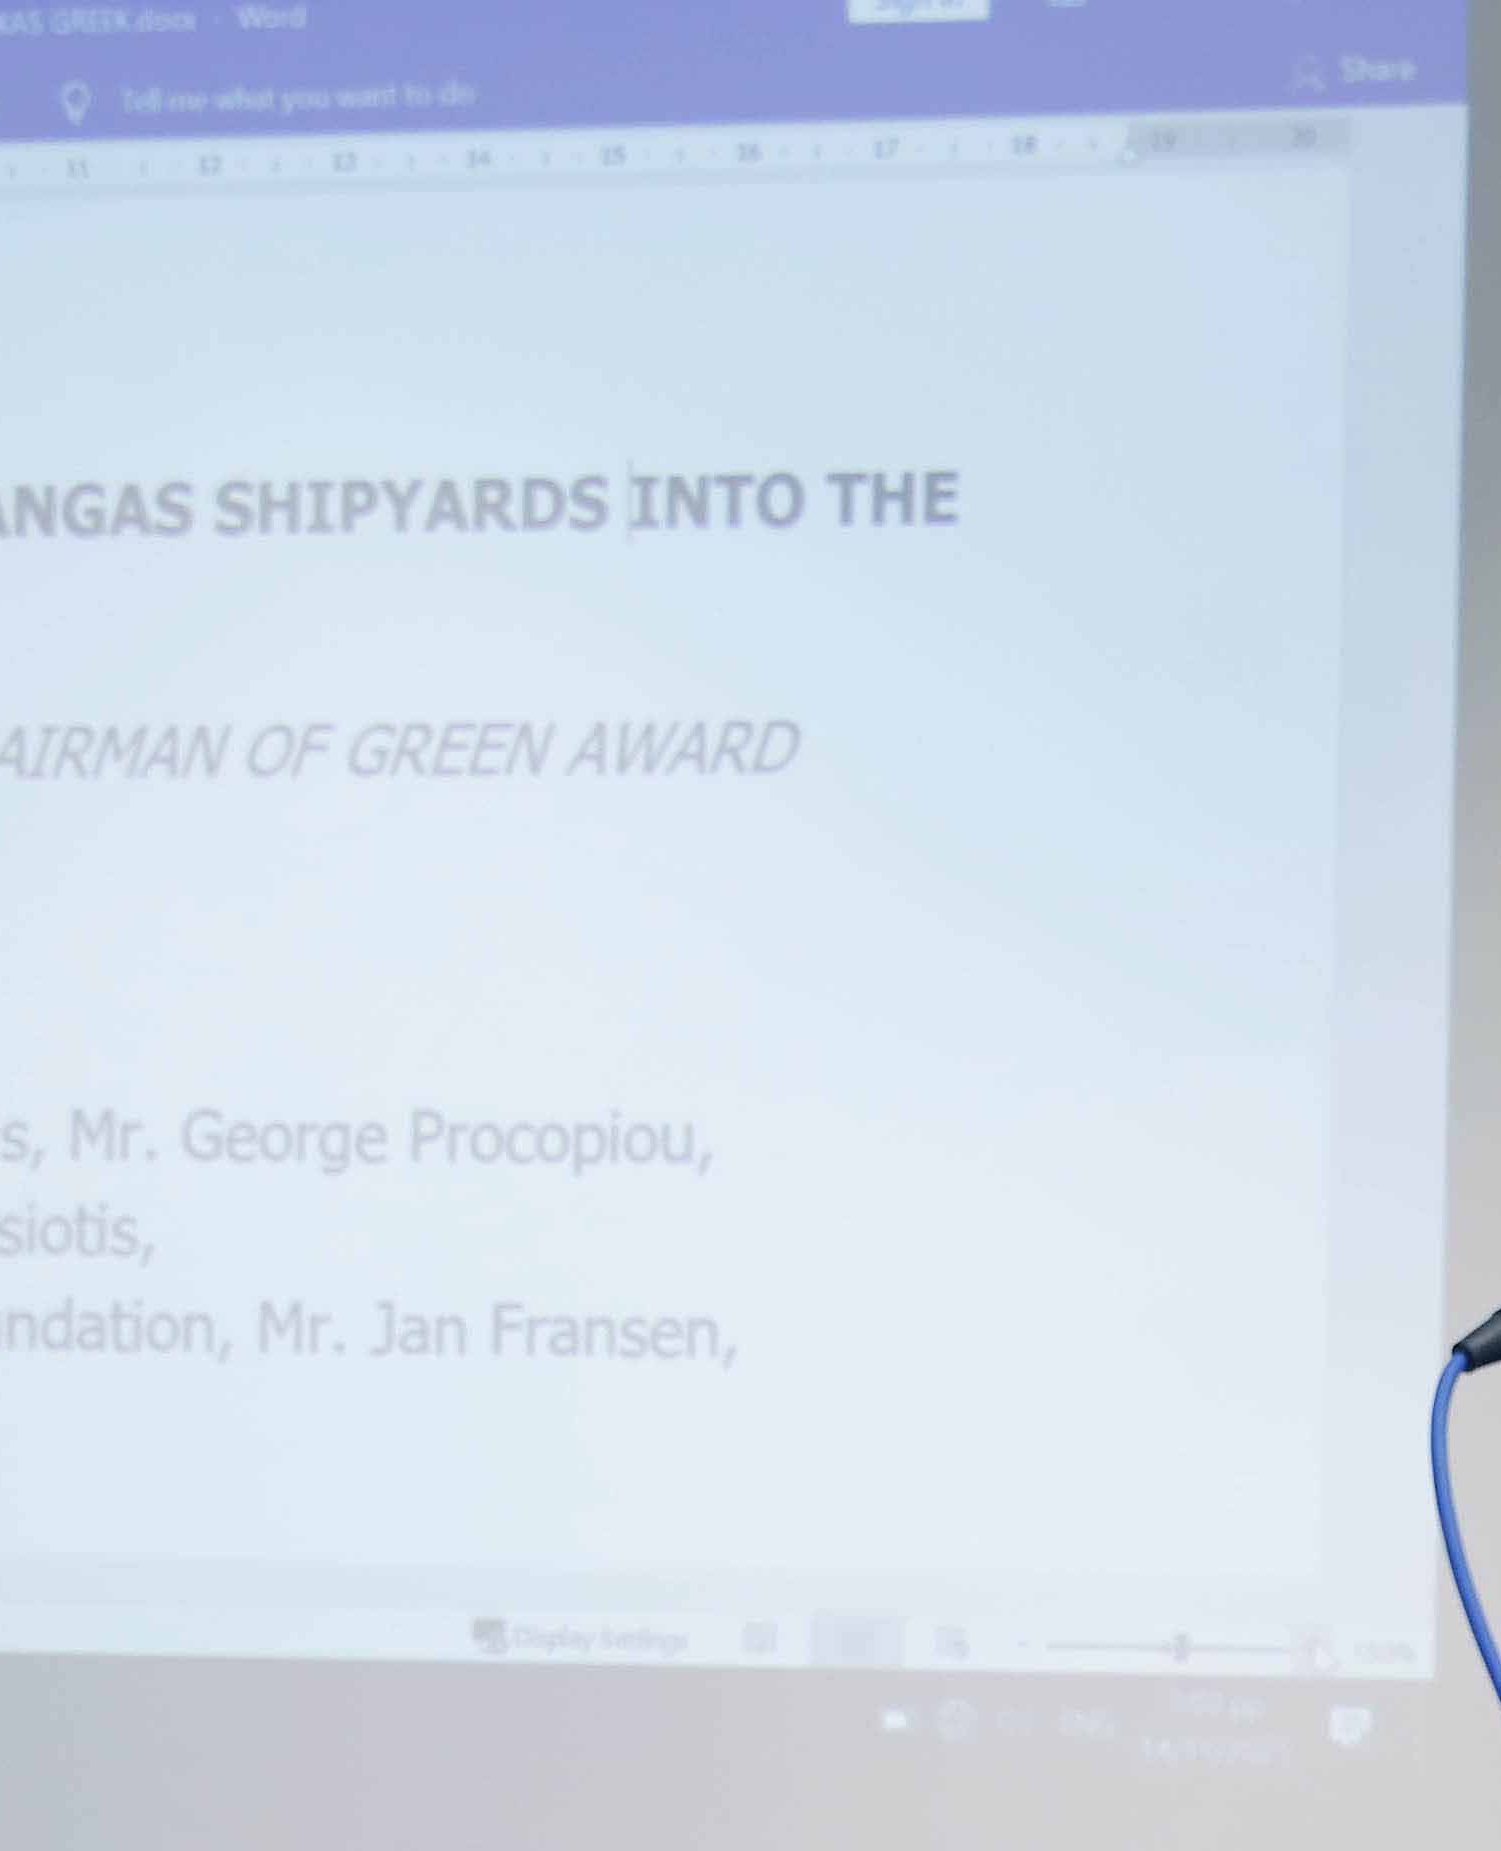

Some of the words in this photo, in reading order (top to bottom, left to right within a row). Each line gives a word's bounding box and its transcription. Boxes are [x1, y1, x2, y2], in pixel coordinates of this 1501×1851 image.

[236, 4, 306, 31] Word
[1339, 55, 1416, 83] Share
[121, 87, 162, 113] Tell
[168, 91, 207, 111] me
[214, 87, 273, 111] what
[281, 90, 328, 115] you
[332, 84, 396, 108] want
[404, 83, 432, 107] to
[438, 79, 475, 105] do
[214, 476, 609, 536] SHIPYARDS
[630, 471, 805, 531] INTO
[826, 470, 960, 527] THE
[245, 723, 333, 777] OF
[346, 720, 551, 777] GREEN
[566, 719, 801, 776] AWARD
[68, 1110, 157, 1163] Mr.
[181, 1108, 388, 1177] George
[410, 1110, 715, 1179] Procopiou,
[257, 1302, 346, 1356] Mr.
[368, 1300, 466, 1358] Jan
[490, 1304, 739, 1370] Fransen,
[513, 1624, 595, 1656] Display
[600, 1624, 688, 1659] Settings
